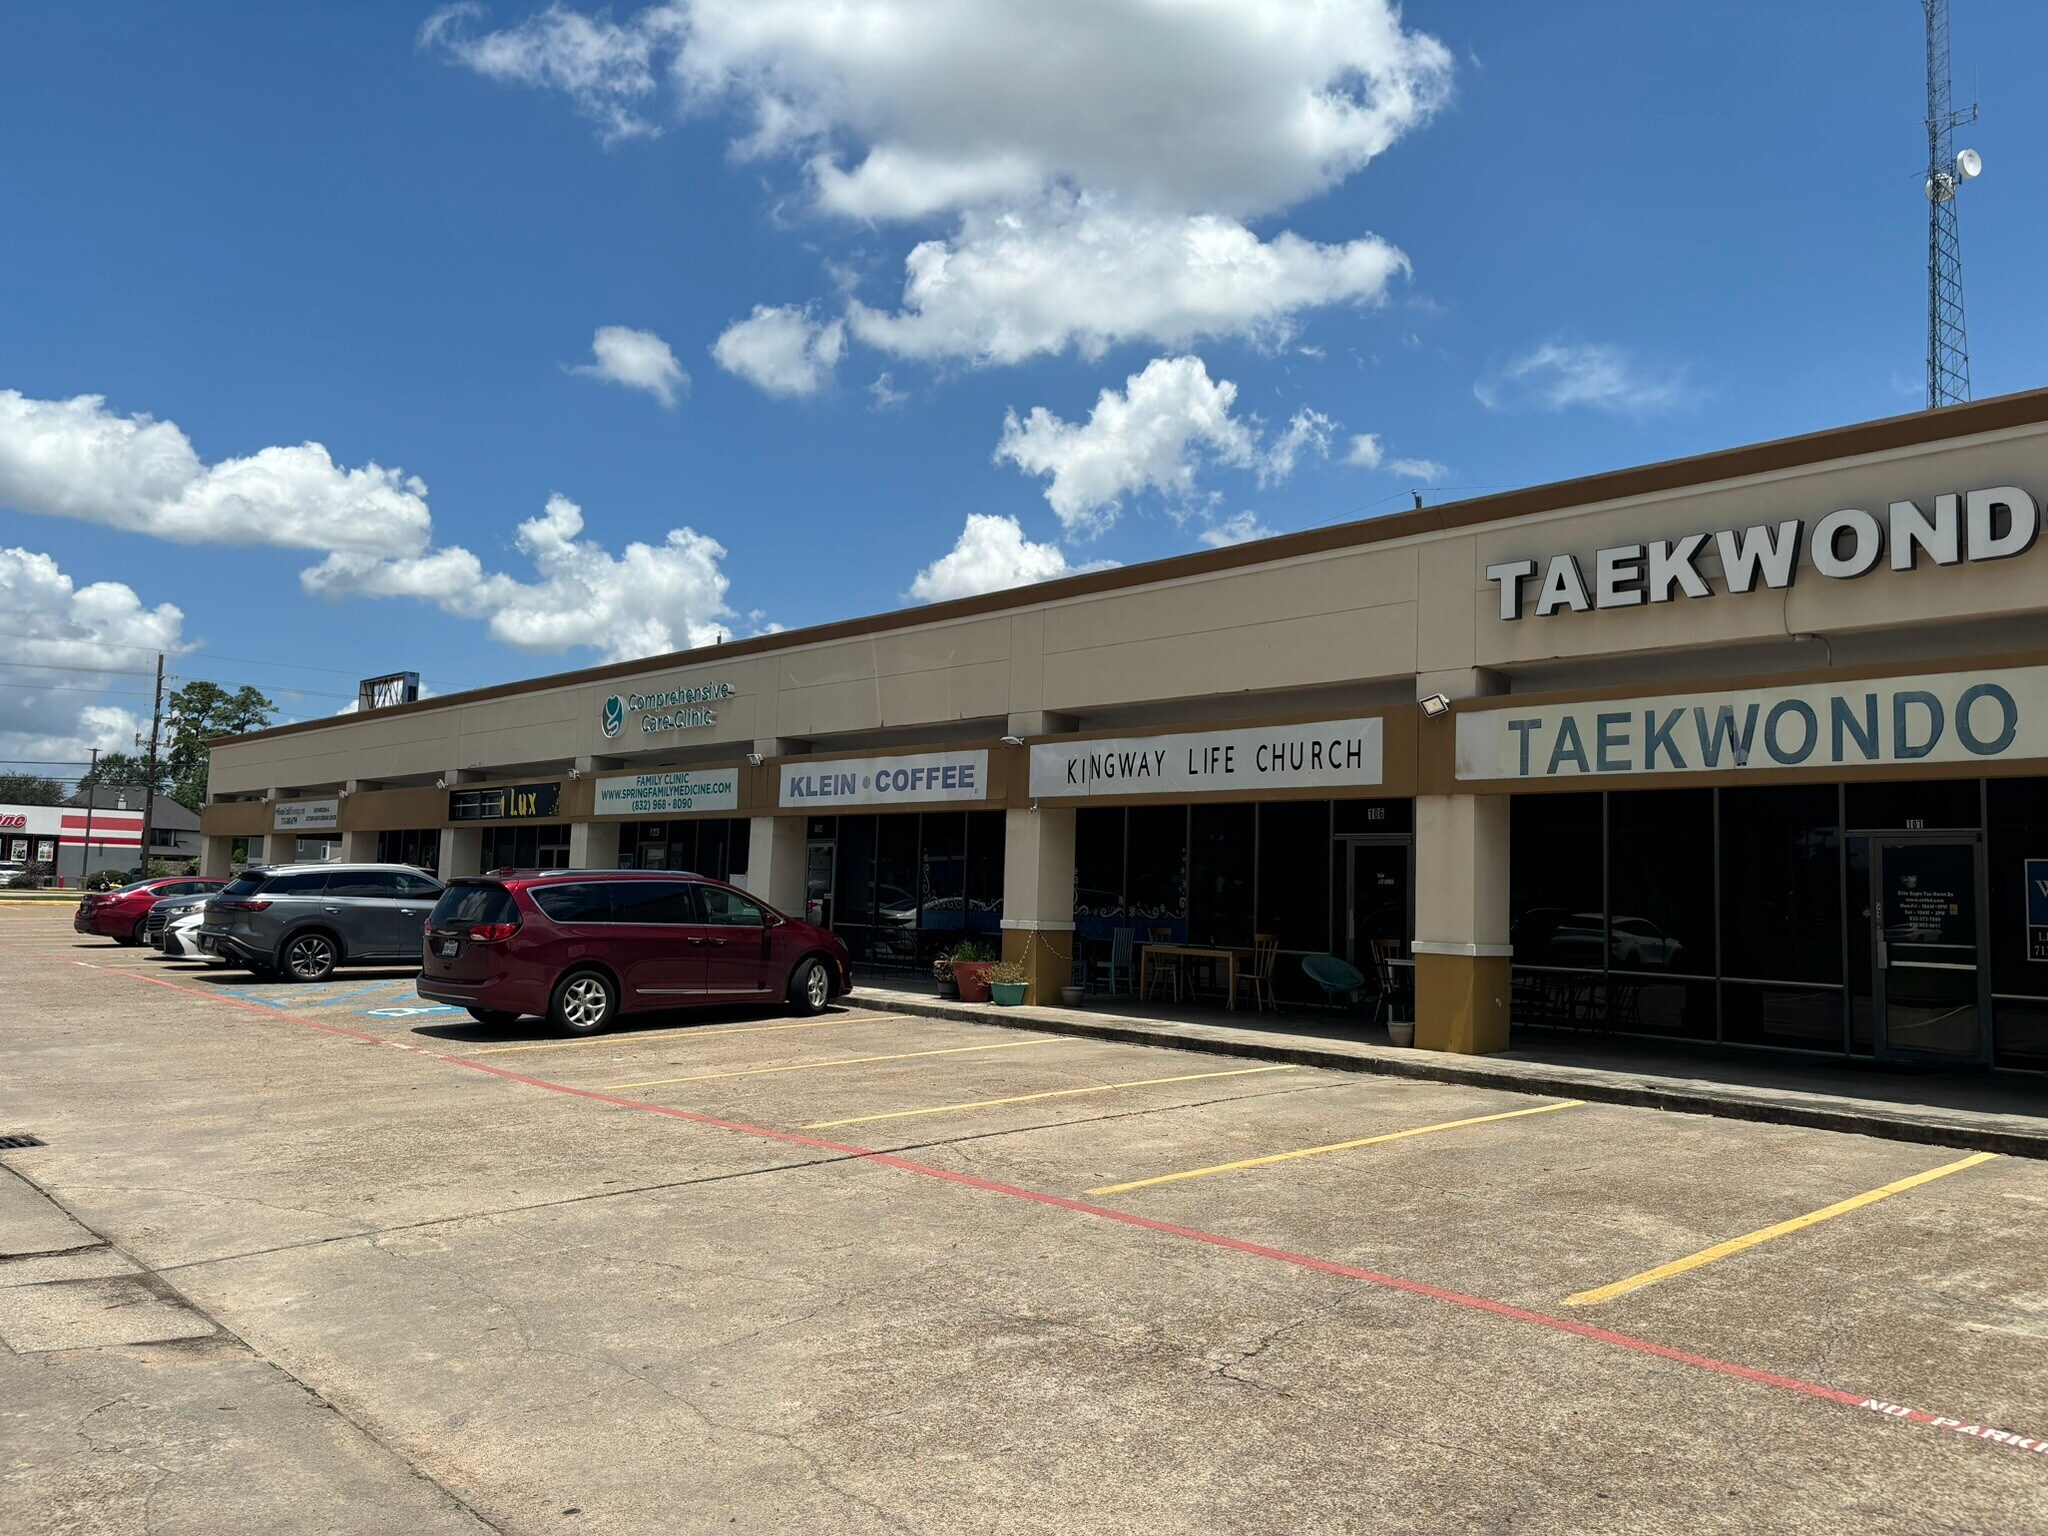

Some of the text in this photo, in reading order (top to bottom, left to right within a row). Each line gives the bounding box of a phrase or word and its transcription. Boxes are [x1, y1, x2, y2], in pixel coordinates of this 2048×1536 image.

[1486, 486, 2048, 621] TAEKWOND
[628, 681, 734, 712] Comprehensive
[641, 706, 716, 733] Care Clinic
[1508, 683, 2018, 776] TAEKWONDO
[1067, 738, 1362, 784] KINGWAY LIFE CHURCH
[601, 782, 732, 801] WWW.SPRINGFAMILYMEDICINE.COM
[636, 773, 690, 787] FAMILY CLINIC
[789, 764, 976, 798] KLEIN COFFEE
[631, 800, 651, 812] (832)
[652, 799, 667, 810] 968
[672, 797, 693, 809] 8090
[1367, 808, 1385, 820] 106
[1859, 1399, 2048, 1455] NO PARKI
